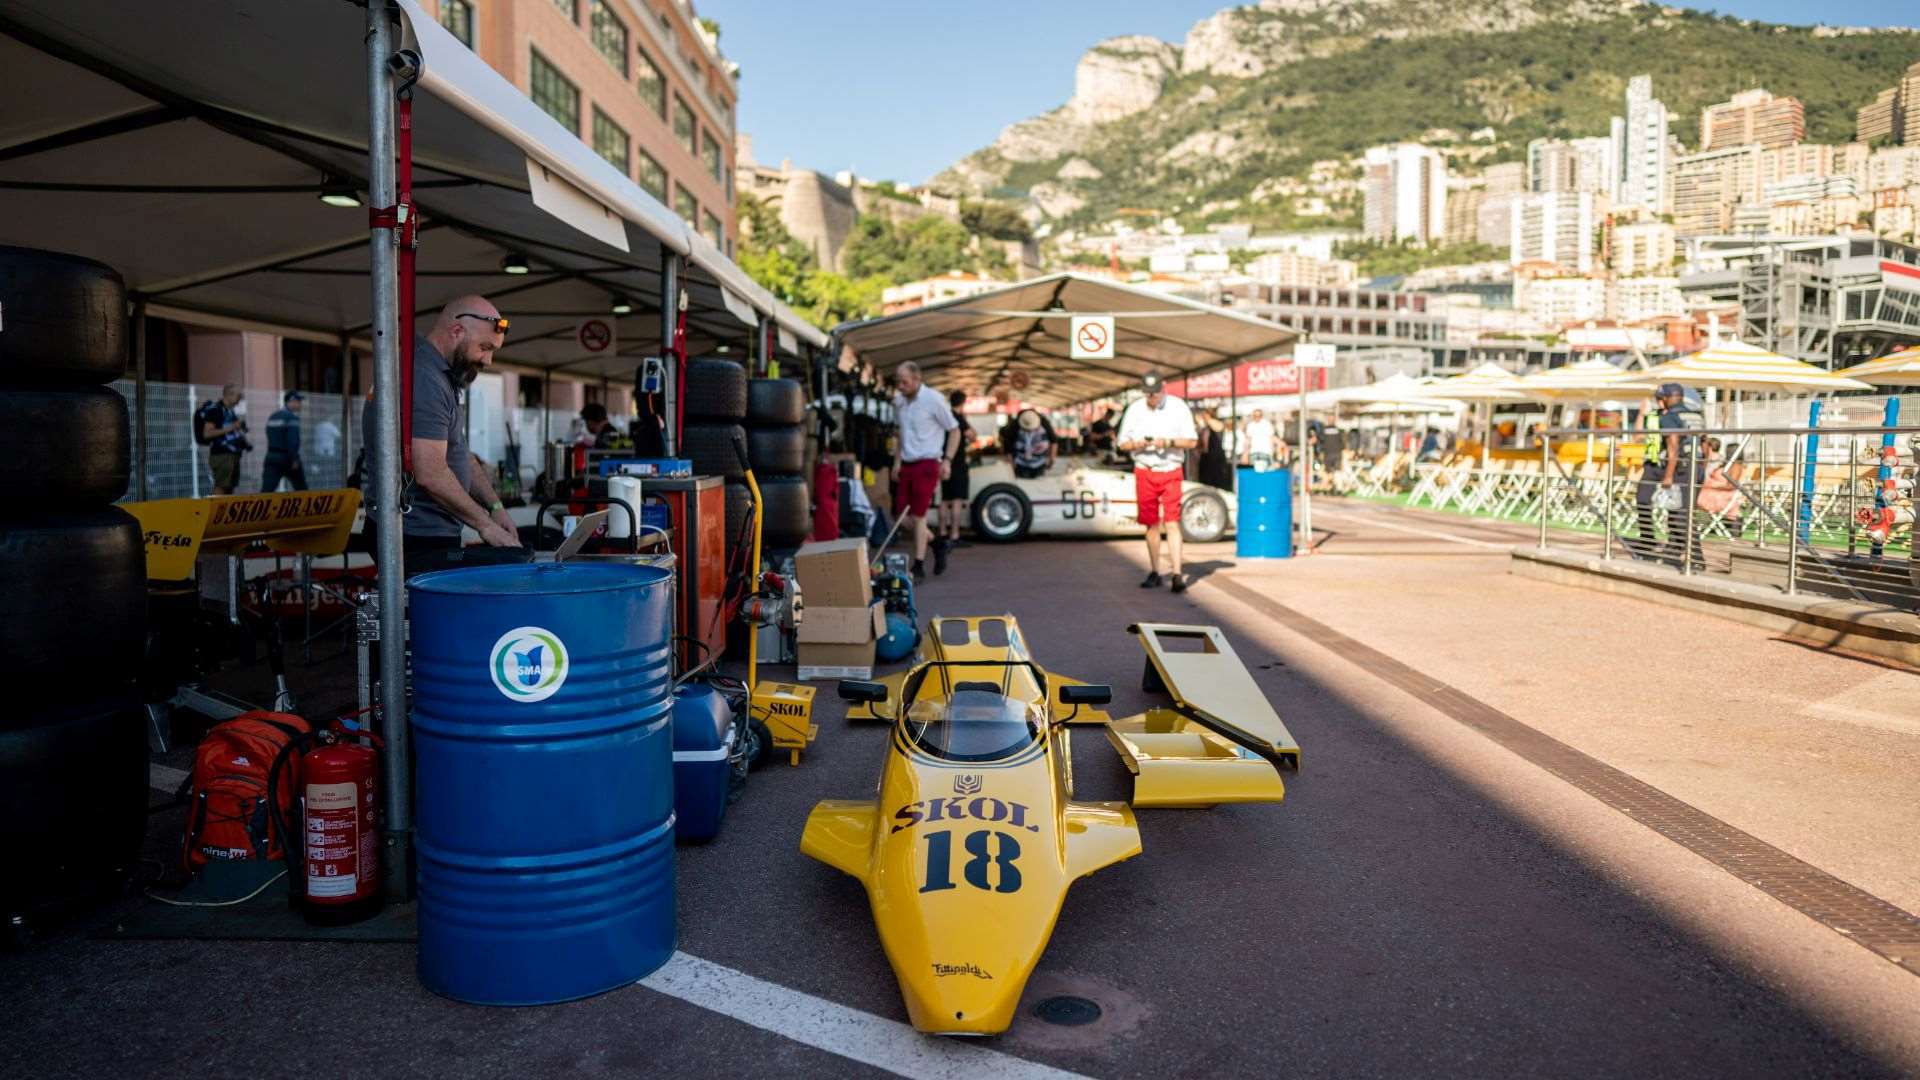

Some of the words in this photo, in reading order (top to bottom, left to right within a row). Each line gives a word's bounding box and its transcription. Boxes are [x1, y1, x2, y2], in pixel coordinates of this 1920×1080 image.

[1061, 489, 1096, 519] 56
[518, 665, 541, 676] SMA
[769, 701, 807, 717] SKOL
[891, 796, 1040, 834] SKOL
[919, 830, 1022, 893] 18
